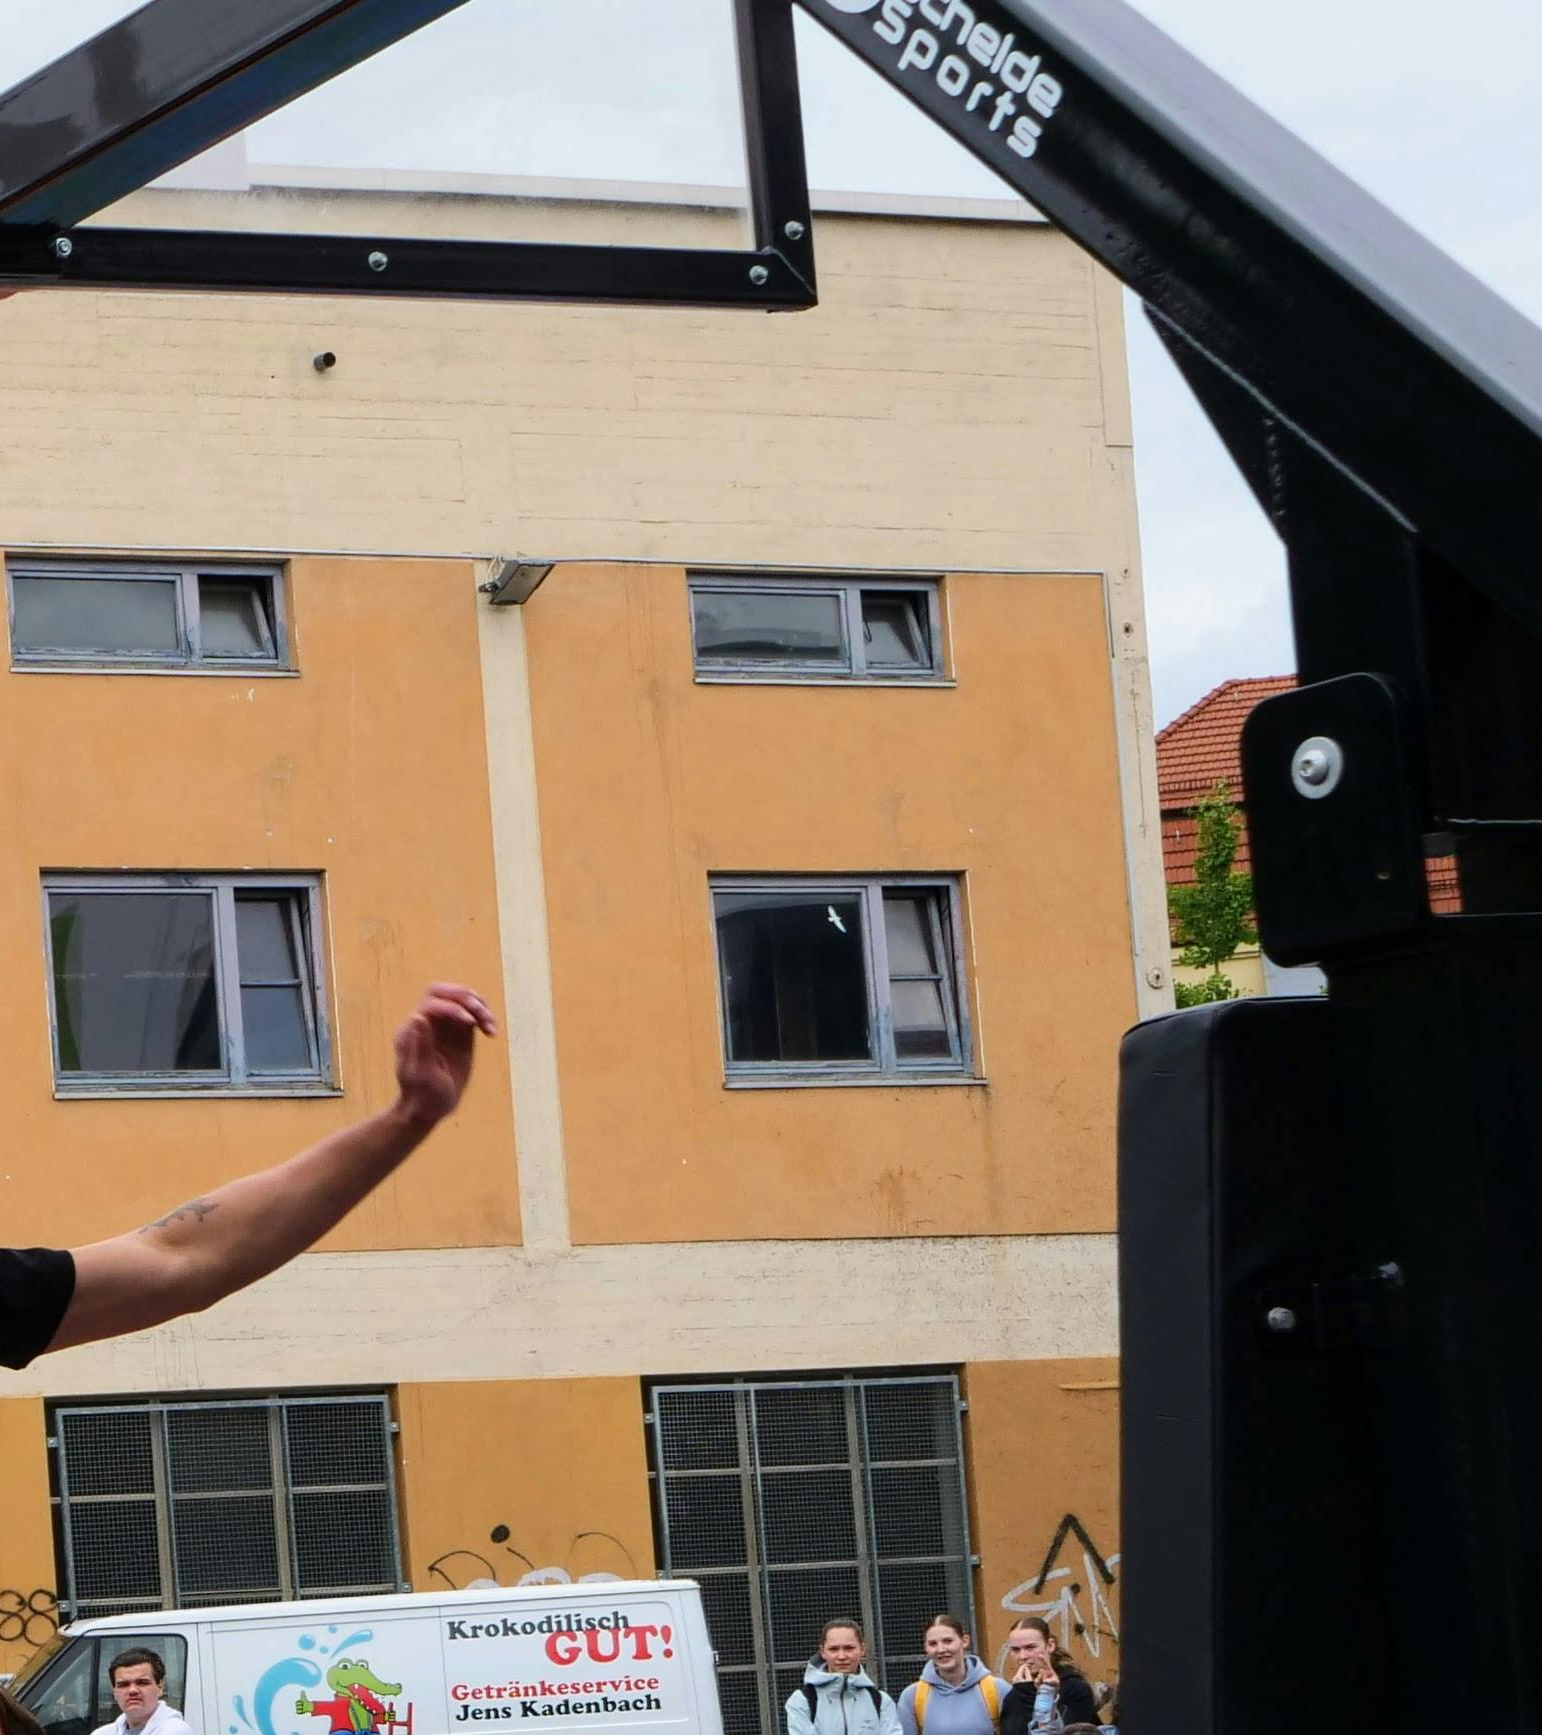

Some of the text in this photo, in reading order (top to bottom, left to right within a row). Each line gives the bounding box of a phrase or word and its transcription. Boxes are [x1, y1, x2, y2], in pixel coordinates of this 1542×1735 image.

[918, 0, 1062, 118] chelde
[448, 1611, 629, 1640] Krokodilisch
[545, 1625, 674, 1666] GUT!
[451, 1675, 660, 1701] Getränkeservice
[456, 1694, 662, 1721] Jens Kadenbach
